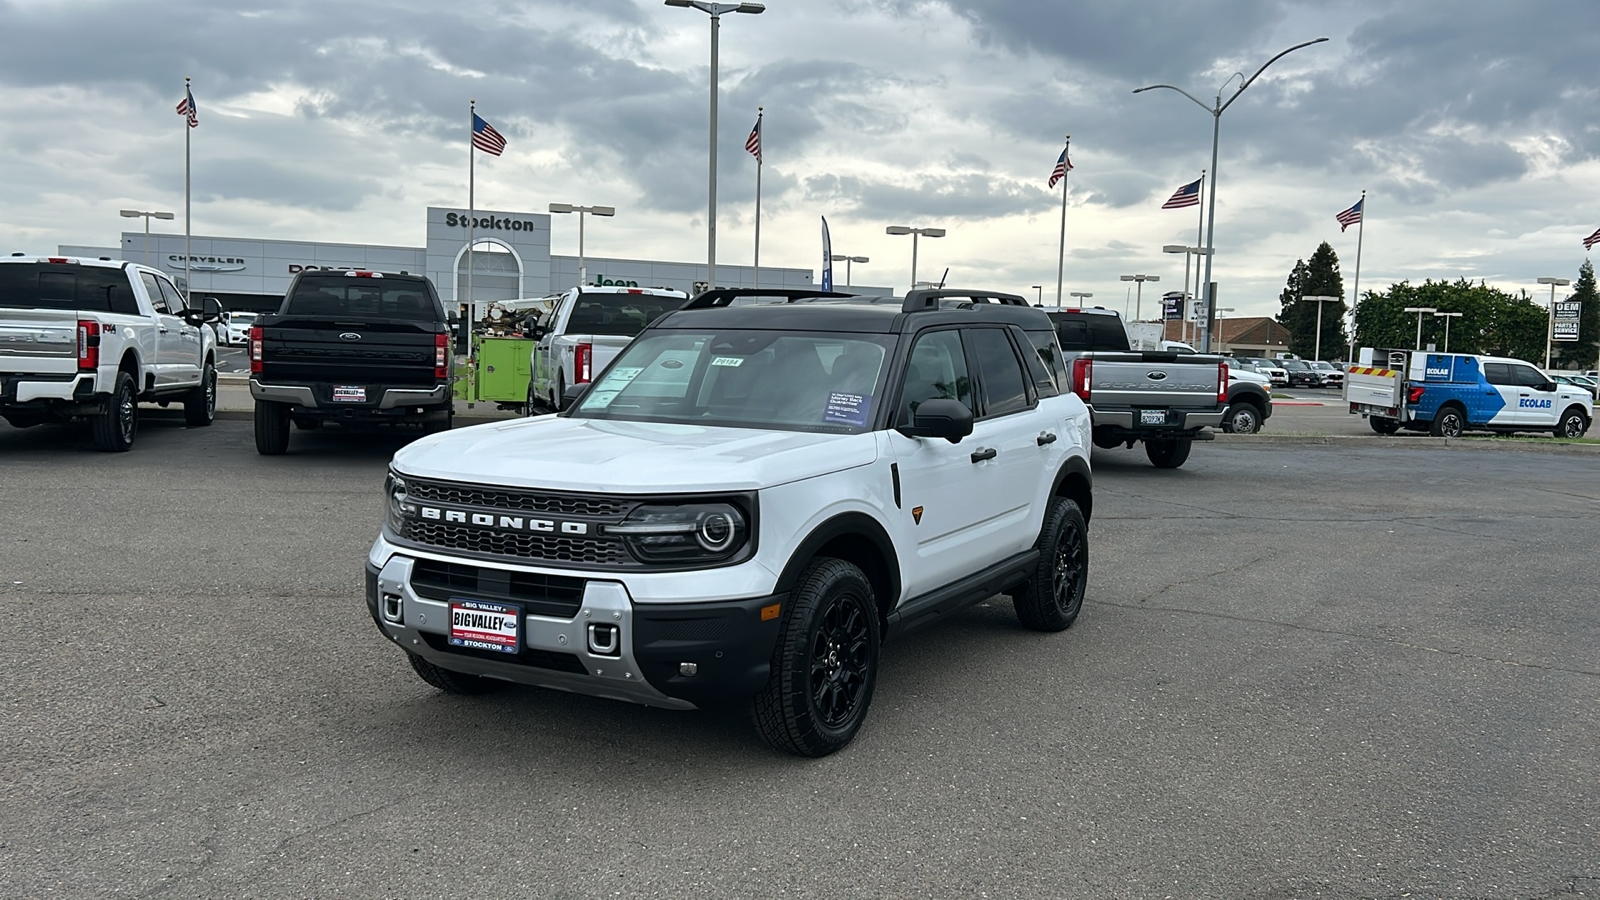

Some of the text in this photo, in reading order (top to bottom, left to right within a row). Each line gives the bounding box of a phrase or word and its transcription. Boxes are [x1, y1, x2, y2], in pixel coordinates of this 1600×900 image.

[446, 212, 534, 232] Stockton
[168, 255, 245, 264] CHRYSLER
[1519, 398, 1552, 408] ECOLAB
[422, 507, 587, 534] BRONCO
[478, 603, 502, 611] VALLEY
[454, 612, 504, 630] BIGVALLEY
[464, 640, 502, 650] STOCKTON
